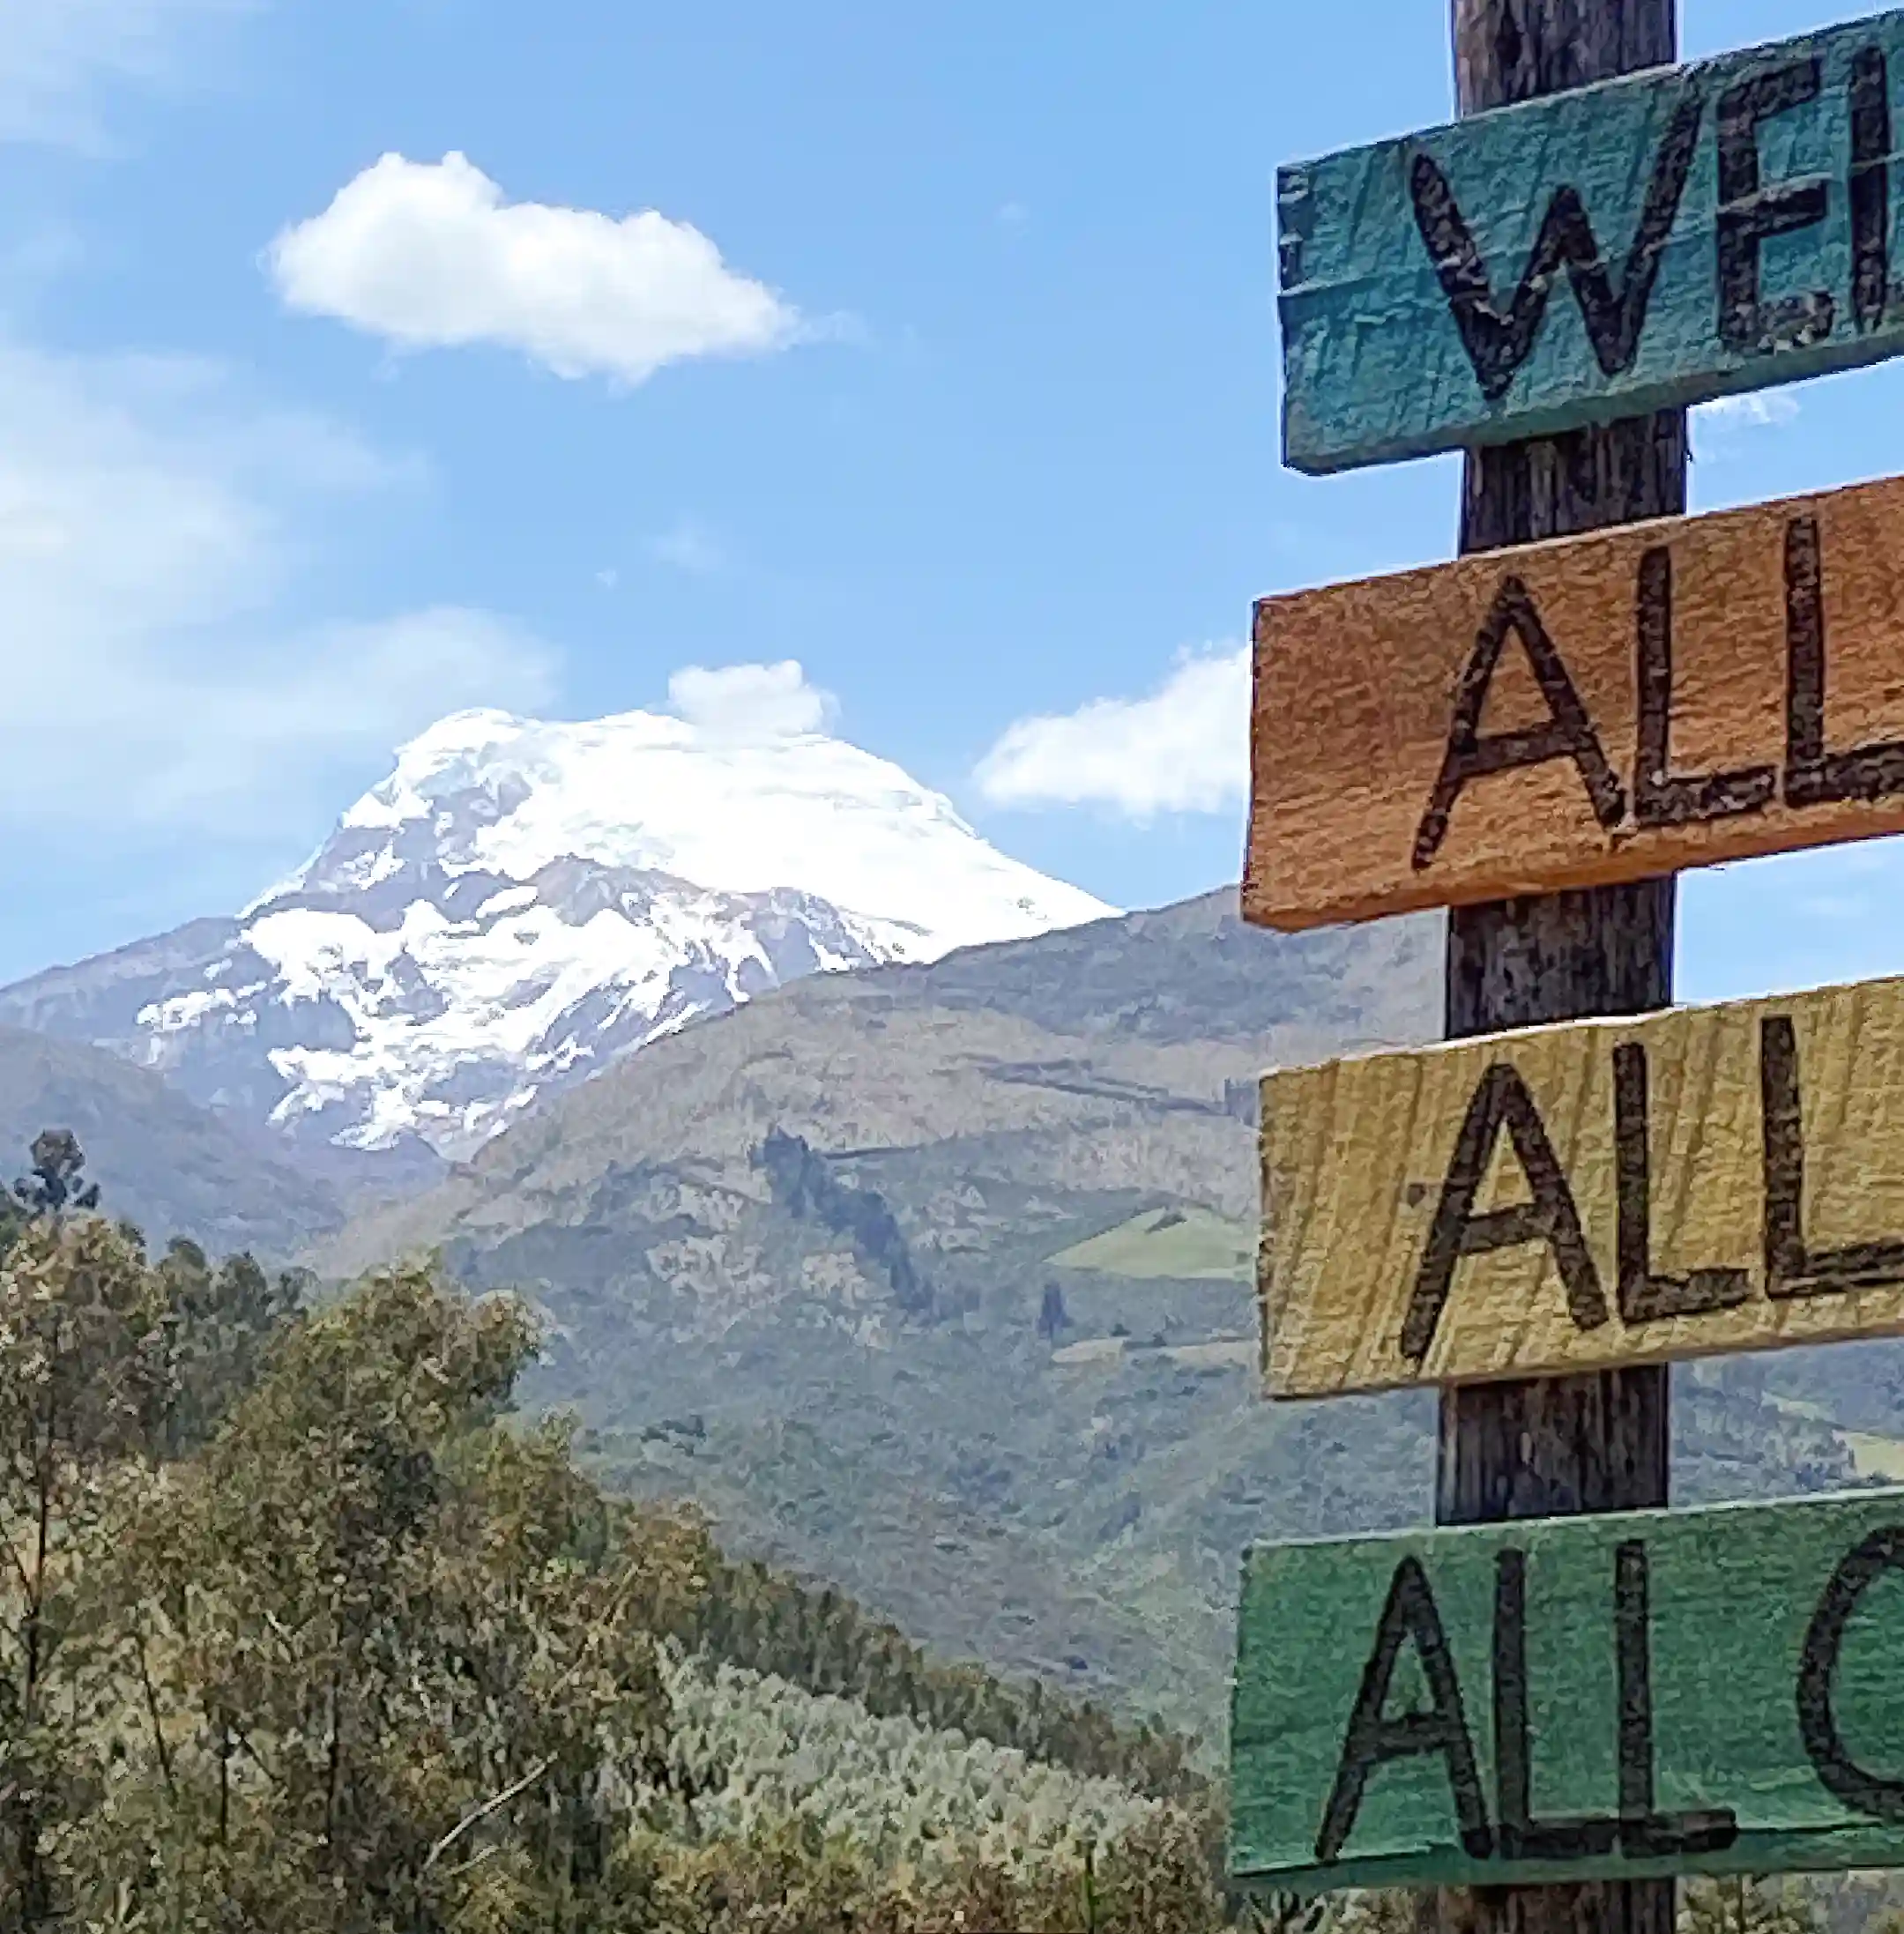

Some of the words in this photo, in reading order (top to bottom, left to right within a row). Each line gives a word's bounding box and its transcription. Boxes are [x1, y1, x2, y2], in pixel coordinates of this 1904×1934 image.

[1410, 516, 1904, 870] ALL
[1400, 1015, 1904, 1359] ALL
[1314, 1539, 1737, 1861] ALL
